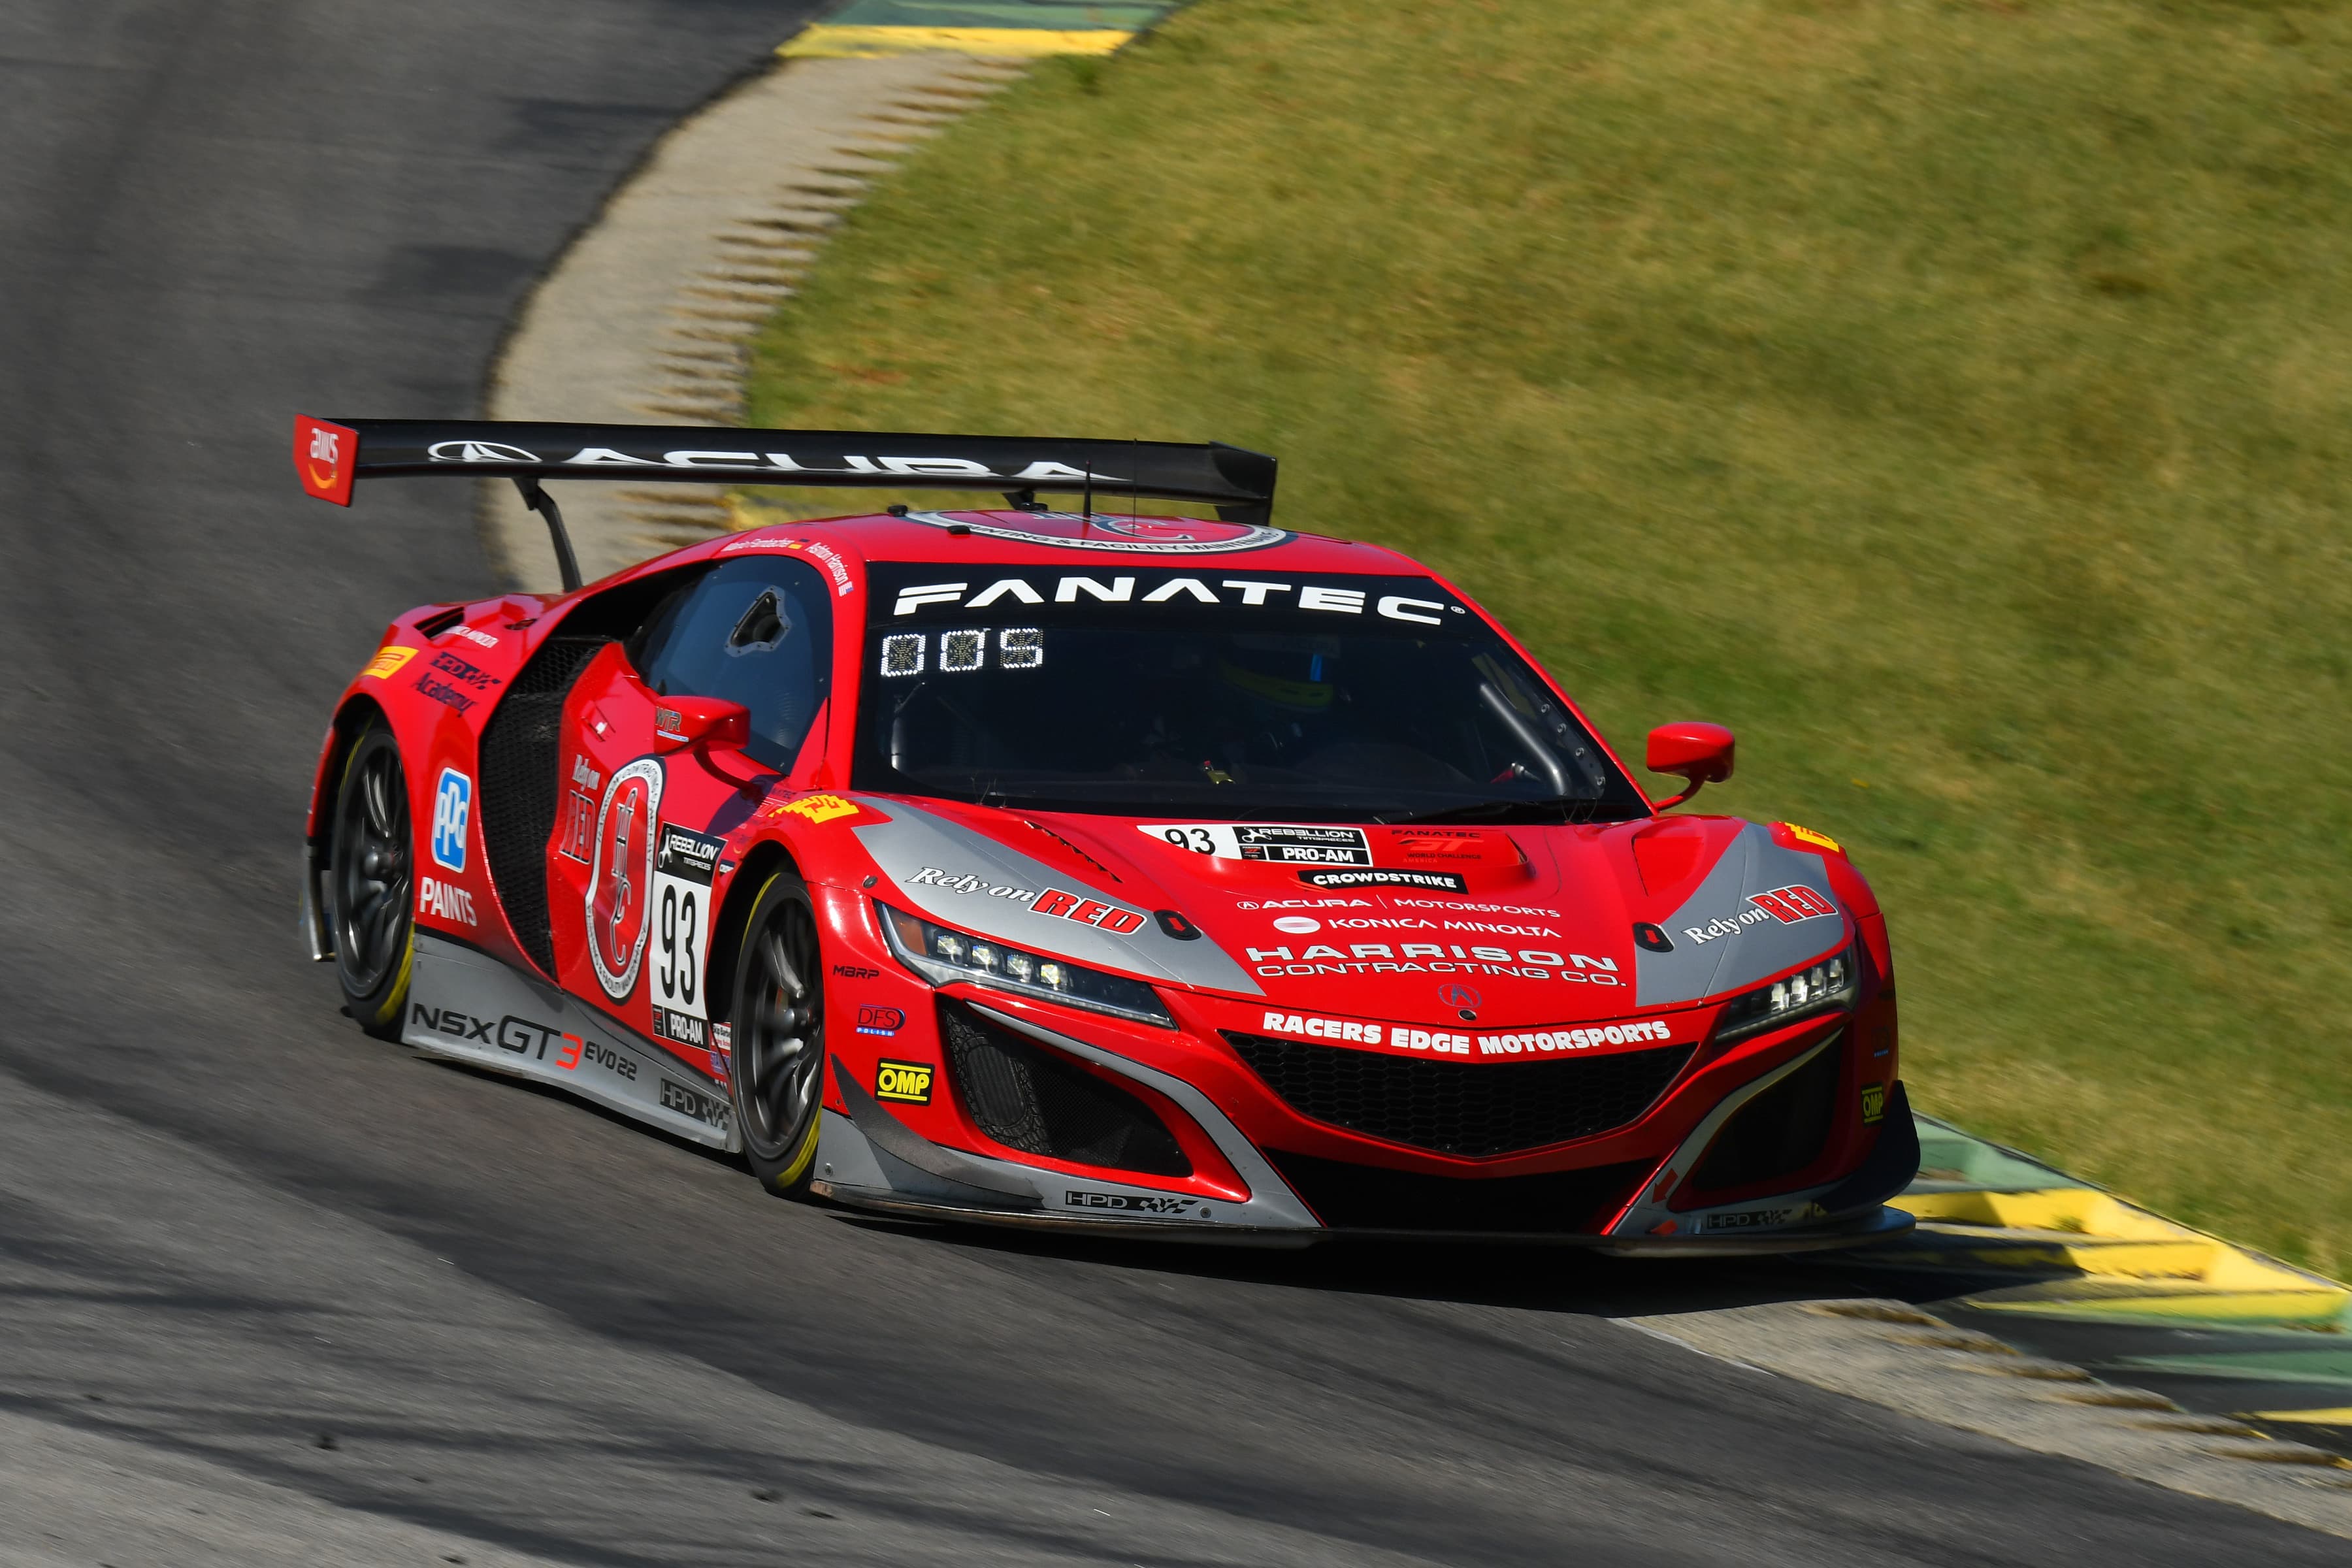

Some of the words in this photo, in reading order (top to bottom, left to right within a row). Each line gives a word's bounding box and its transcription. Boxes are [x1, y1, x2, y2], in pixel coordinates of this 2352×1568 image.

[1080, 540, 1179, 551] FACILITY
[892, 576, 1445, 626] FANATEC
[414, 672, 478, 717] Academy
[434, 781, 466, 856] PPG
[1164, 828, 1216, 856] 93
[1391, 830, 1480, 838] FANATEC
[1282, 847, 1354, 862] PRO-AM
[1313, 872, 1457, 889] CROWDSTRIKE
[419, 876, 477, 926] PAINTS
[904, 866, 990, 894] Rely
[987, 884, 1039, 902] on
[1028, 887, 1147, 935] RED
[1262, 899, 1373, 909] ACURA
[1393, 898, 1561, 918] MOTORSPORTS
[1745, 884, 1838, 925] RED
[1328, 918, 1438, 930] KONICA
[1443, 920, 1563, 938] MINOLTA
[1738, 905, 1769, 926] on
[1681, 916, 1743, 945] Rely
[661, 883, 696, 1005] 93
[1245, 943, 1620, 972] HARRISON
[832, 964, 879, 979] MBRP
[1256, 962, 1550, 979] CONTRACTING
[1560, 970, 1627, 987] CO.
[670, 1013, 704, 1045] PRO-AM
[857, 1007, 898, 1028] DFS
[857, 1027, 893, 1036] POLISH
[1263, 1011, 1382, 1045] RACERS
[1390, 1027, 1470, 1054] EDGE
[1477, 1020, 1671, 1054] MOTORSPORTS
[878, 1068, 930, 1095] OMP
[661, 1080, 696, 1115] HPD
[1863, 1092, 1884, 1117] OMP
[1067, 1192, 1128, 1208] HPD
[1708, 1214, 1750, 1228] HPD
